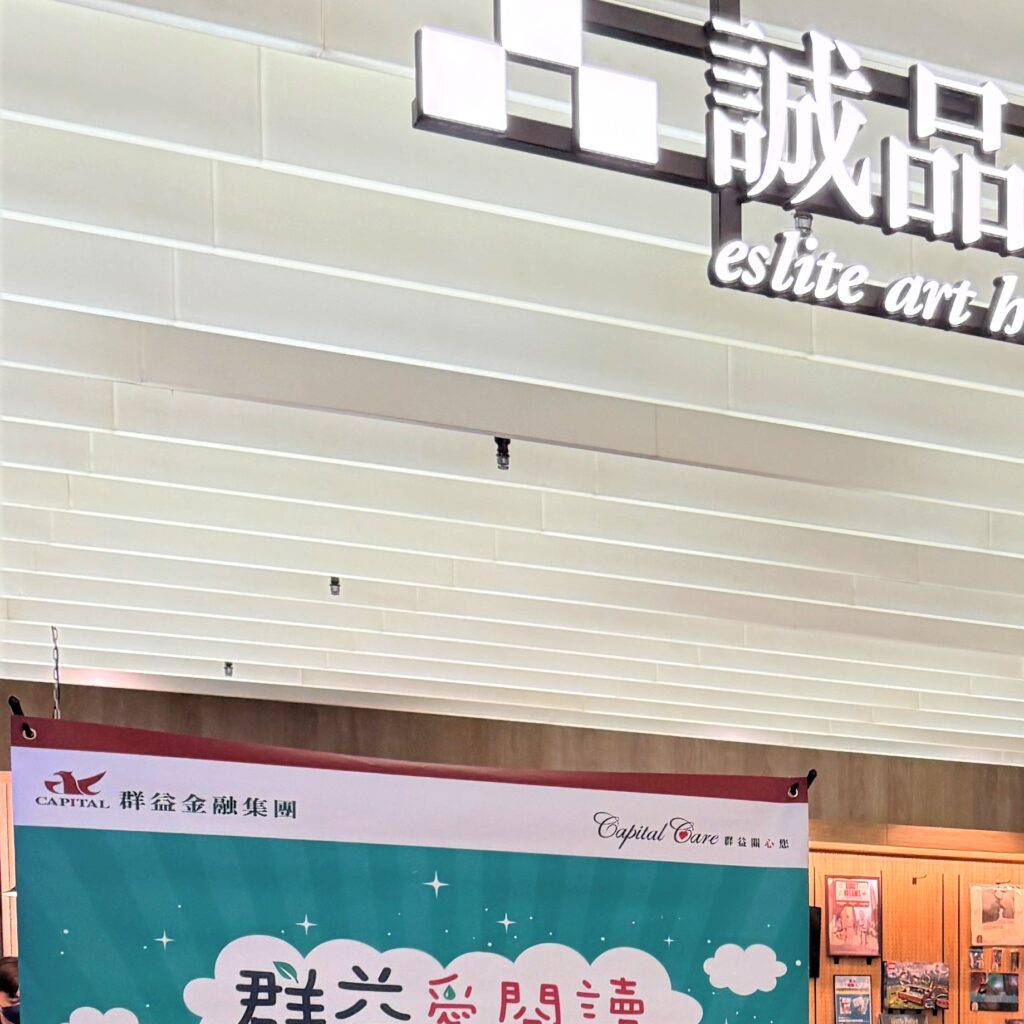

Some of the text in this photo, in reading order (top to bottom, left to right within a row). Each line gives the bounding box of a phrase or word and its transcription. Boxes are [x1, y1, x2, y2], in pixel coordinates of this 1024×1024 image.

[713, 232, 869, 304] eslite
[884, 273, 977, 326] art
[35, 795, 110, 809] CAPITAL
[119, 790, 297, 819] 群益金融集團
[593, 811, 789, 849] Capital Care 群益關心您
